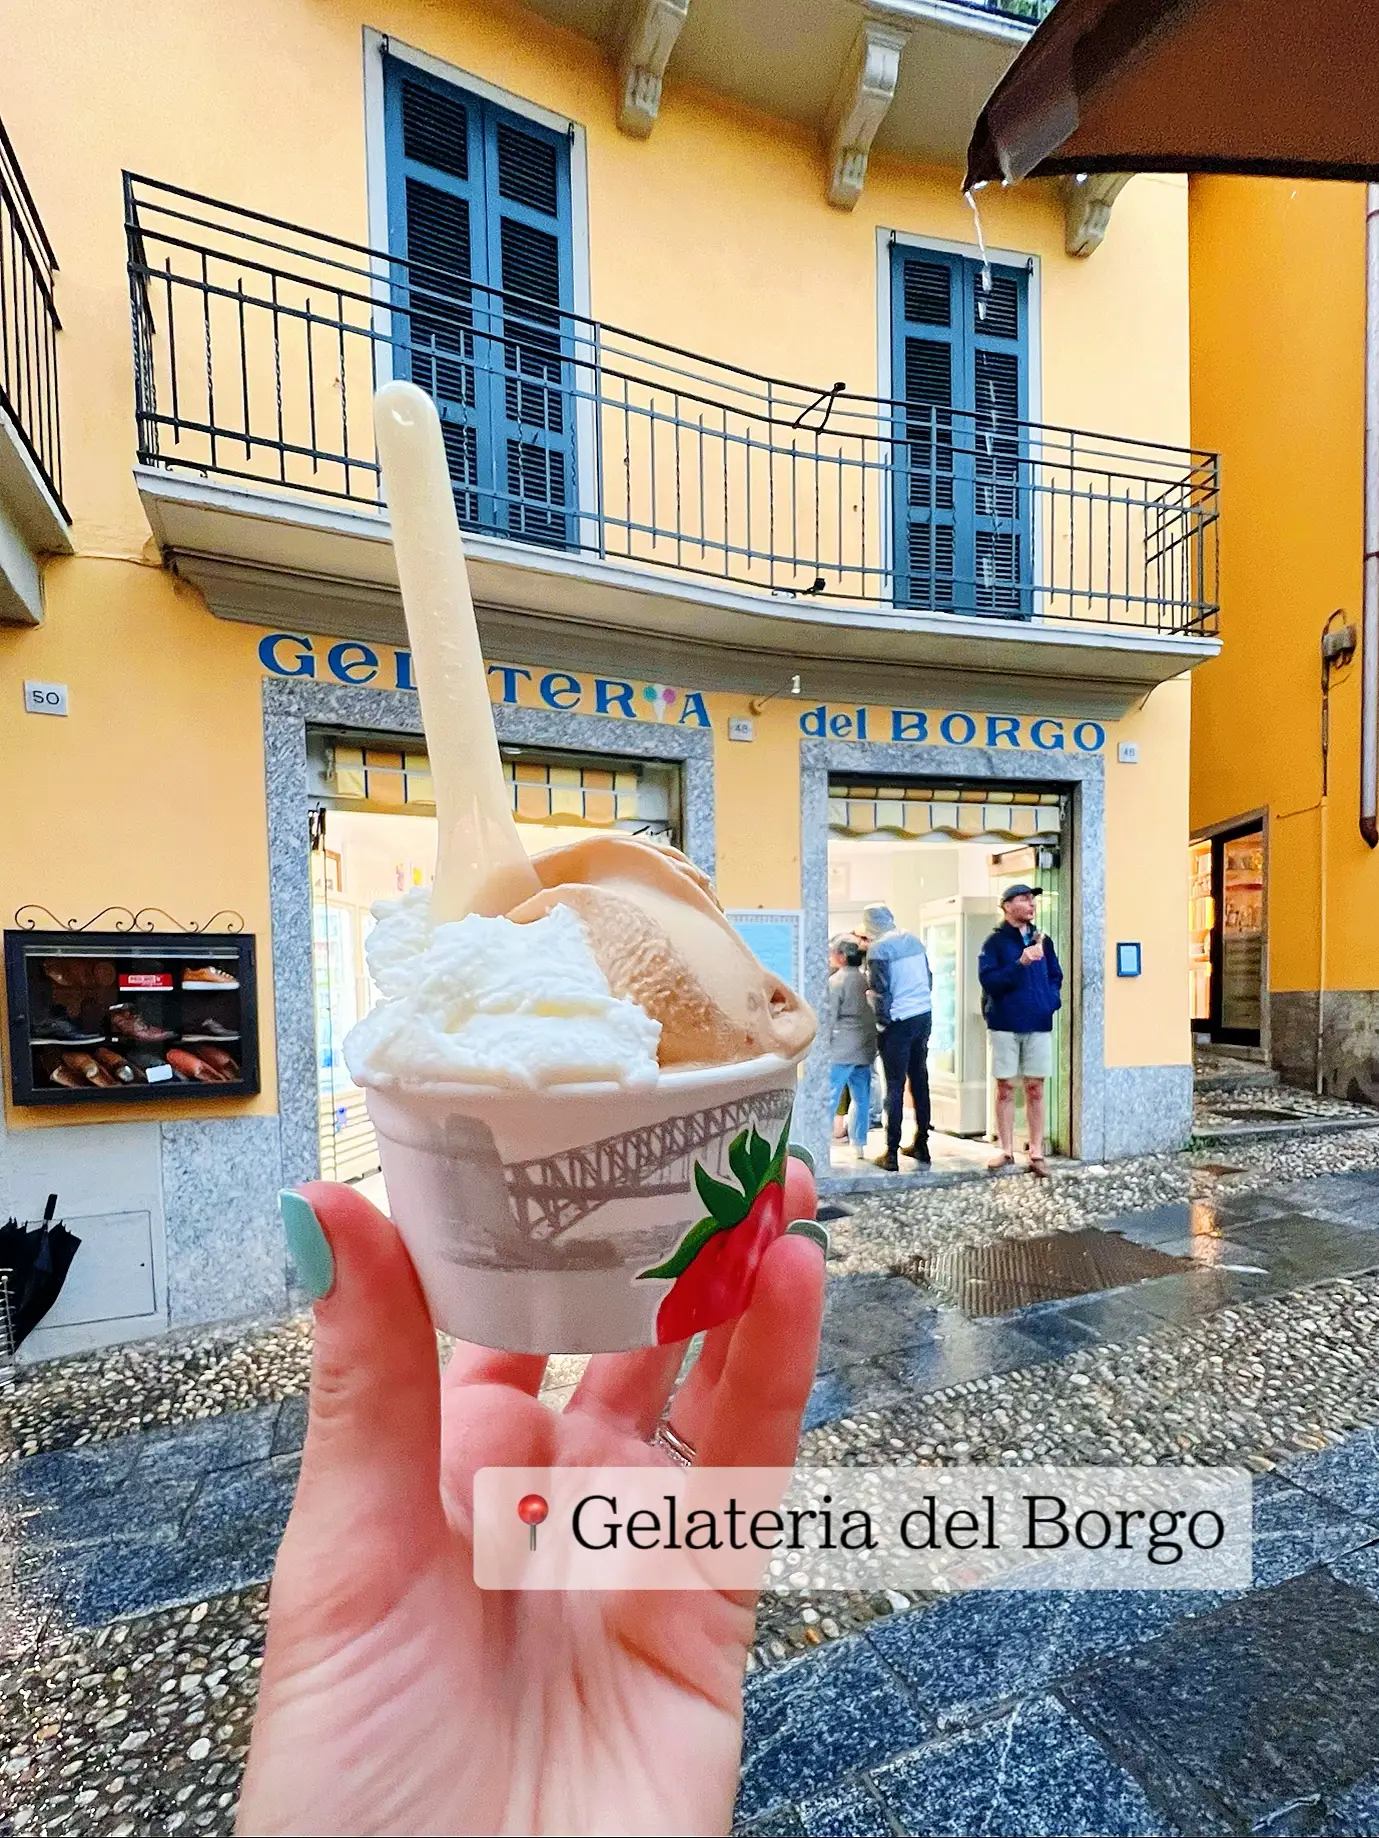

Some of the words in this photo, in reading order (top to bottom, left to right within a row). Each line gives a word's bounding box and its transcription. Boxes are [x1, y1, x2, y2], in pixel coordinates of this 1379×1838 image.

[32, 690, 60, 705] 50
[799, 705, 867, 740] del
[891, 709, 1105, 751] BORGO
